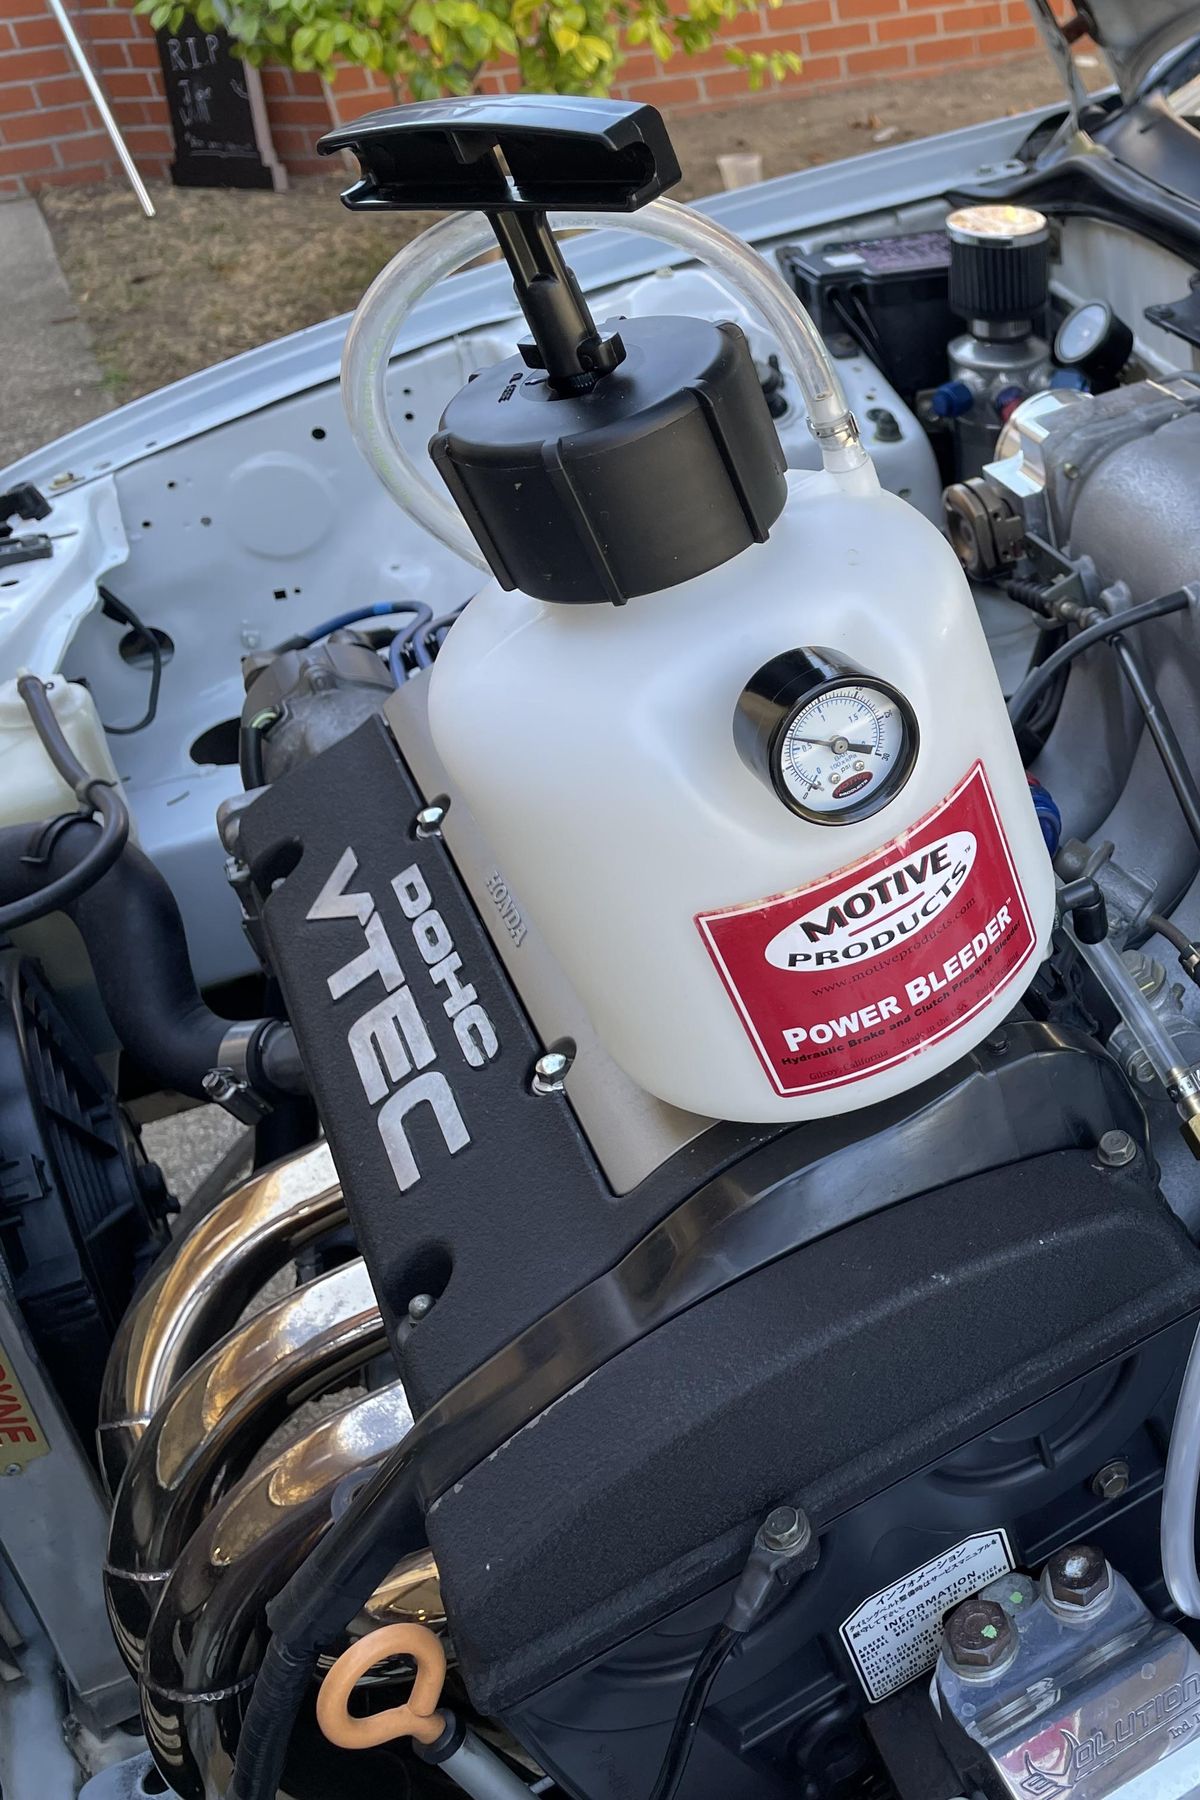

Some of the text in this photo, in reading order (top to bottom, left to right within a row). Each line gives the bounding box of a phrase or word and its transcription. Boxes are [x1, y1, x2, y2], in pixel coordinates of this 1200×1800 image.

[486, 869, 529, 949] HONDA
[787, 860, 968, 968] PRODUCTS
[800, 842, 952, 944] MOTIVE
[390, 863, 500, 1068] DOHC
[781, 904, 1013, 1053] POWER BLEEDER
[781, 919, 1021, 1066] Hydraulic Brake and Clutch Pressure Bleeder
[810, 896, 977, 998] www.motiveproducts.com
[305, 846, 472, 1192] VTEC
[843, 1050, 889, 1071] California
[876, 1547, 966, 1605] インフォメーション
[884, 1571, 976, 1631] INFORMATION
